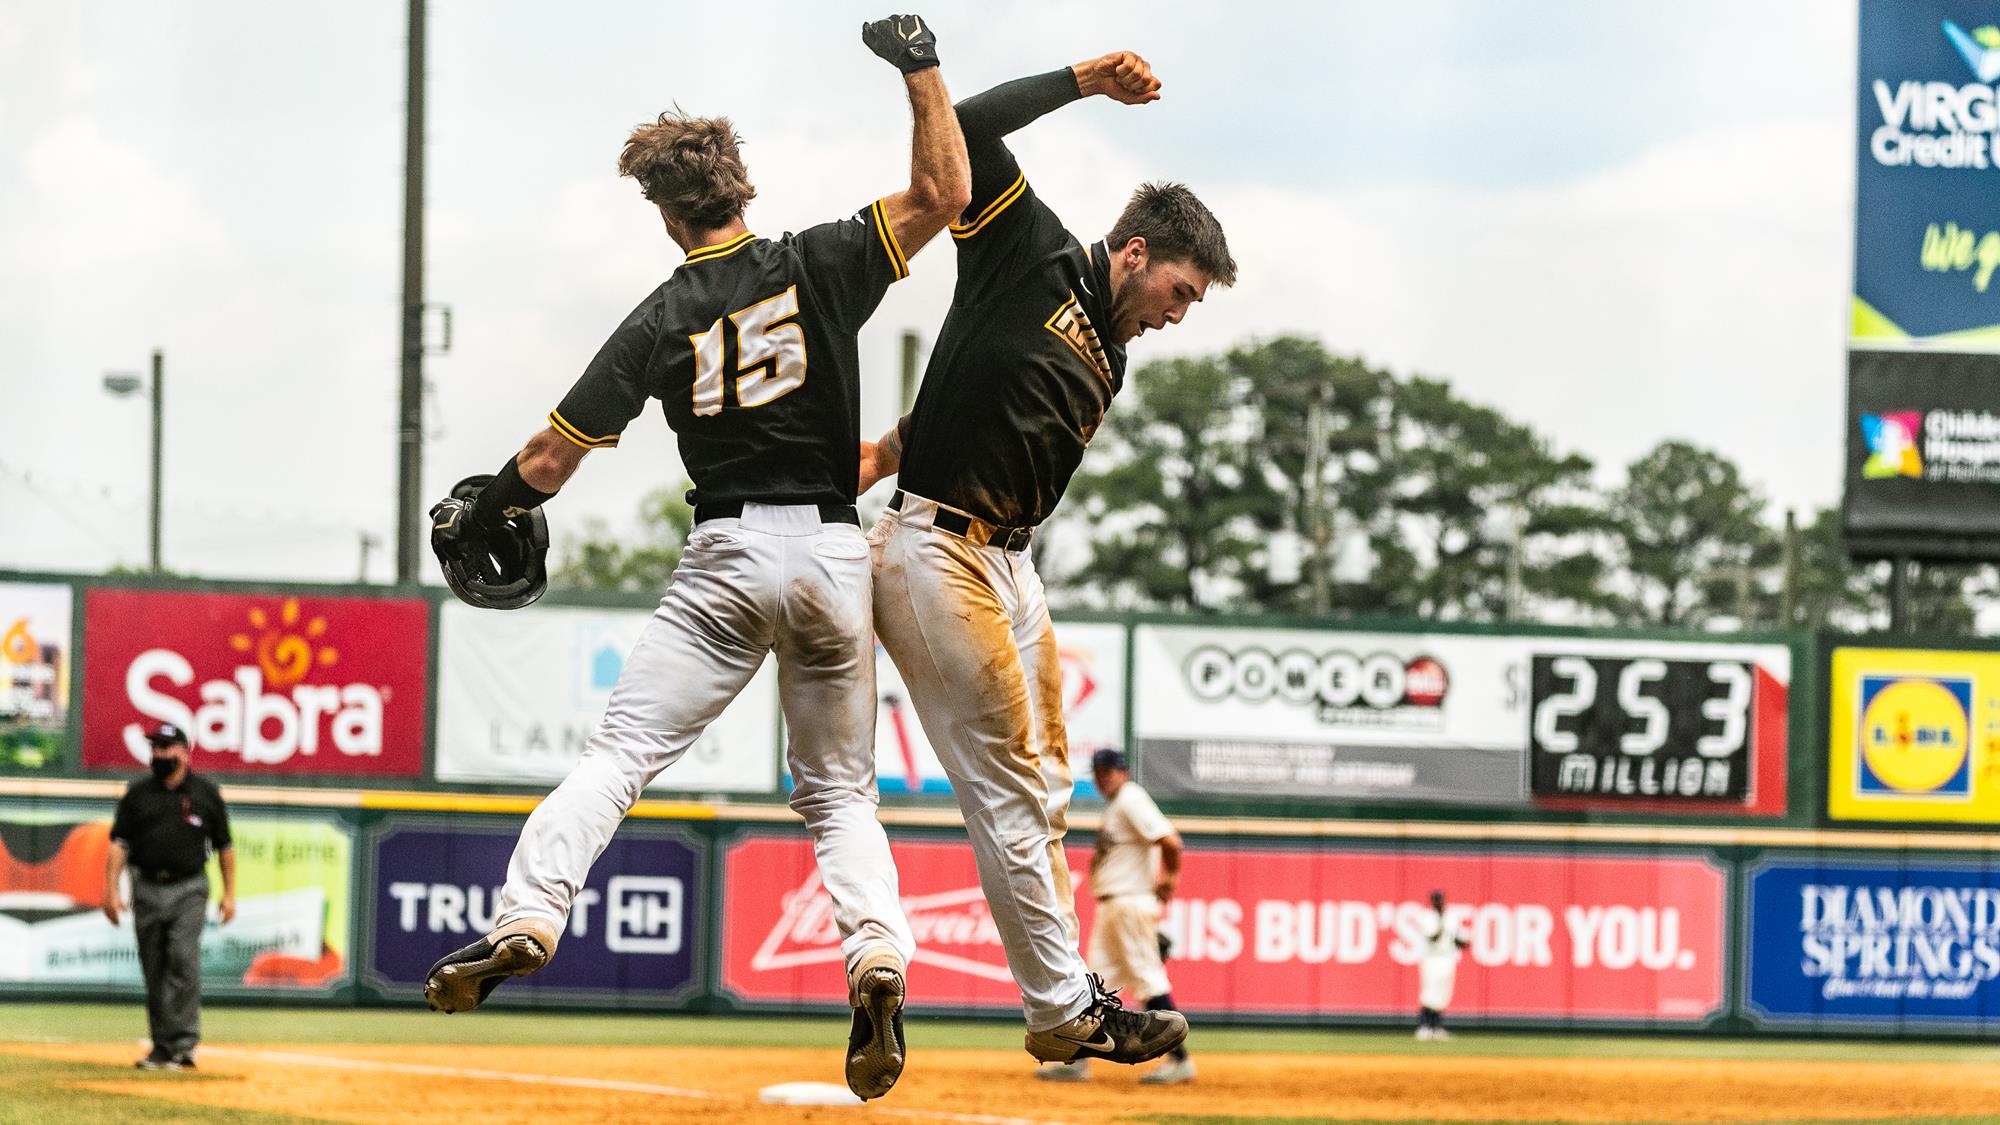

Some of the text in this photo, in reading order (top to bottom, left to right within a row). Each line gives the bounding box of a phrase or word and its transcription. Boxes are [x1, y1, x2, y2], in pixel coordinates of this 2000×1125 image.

[1872, 79, 2000, 134] VIRG
[1871, 125, 1989, 169] Credit
[688, 284, 807, 417] 15
[123, 648, 384, 767] Sabra
[1535, 657, 1750, 757] 253
[1558, 754, 1731, 796] MILLION
[1165, 898, 1696, 970] HIS BUD'S FOR YOU.
[1801, 884, 2000, 942] DIAMOND
[1801, 931, 2000, 981] SPRINGS
